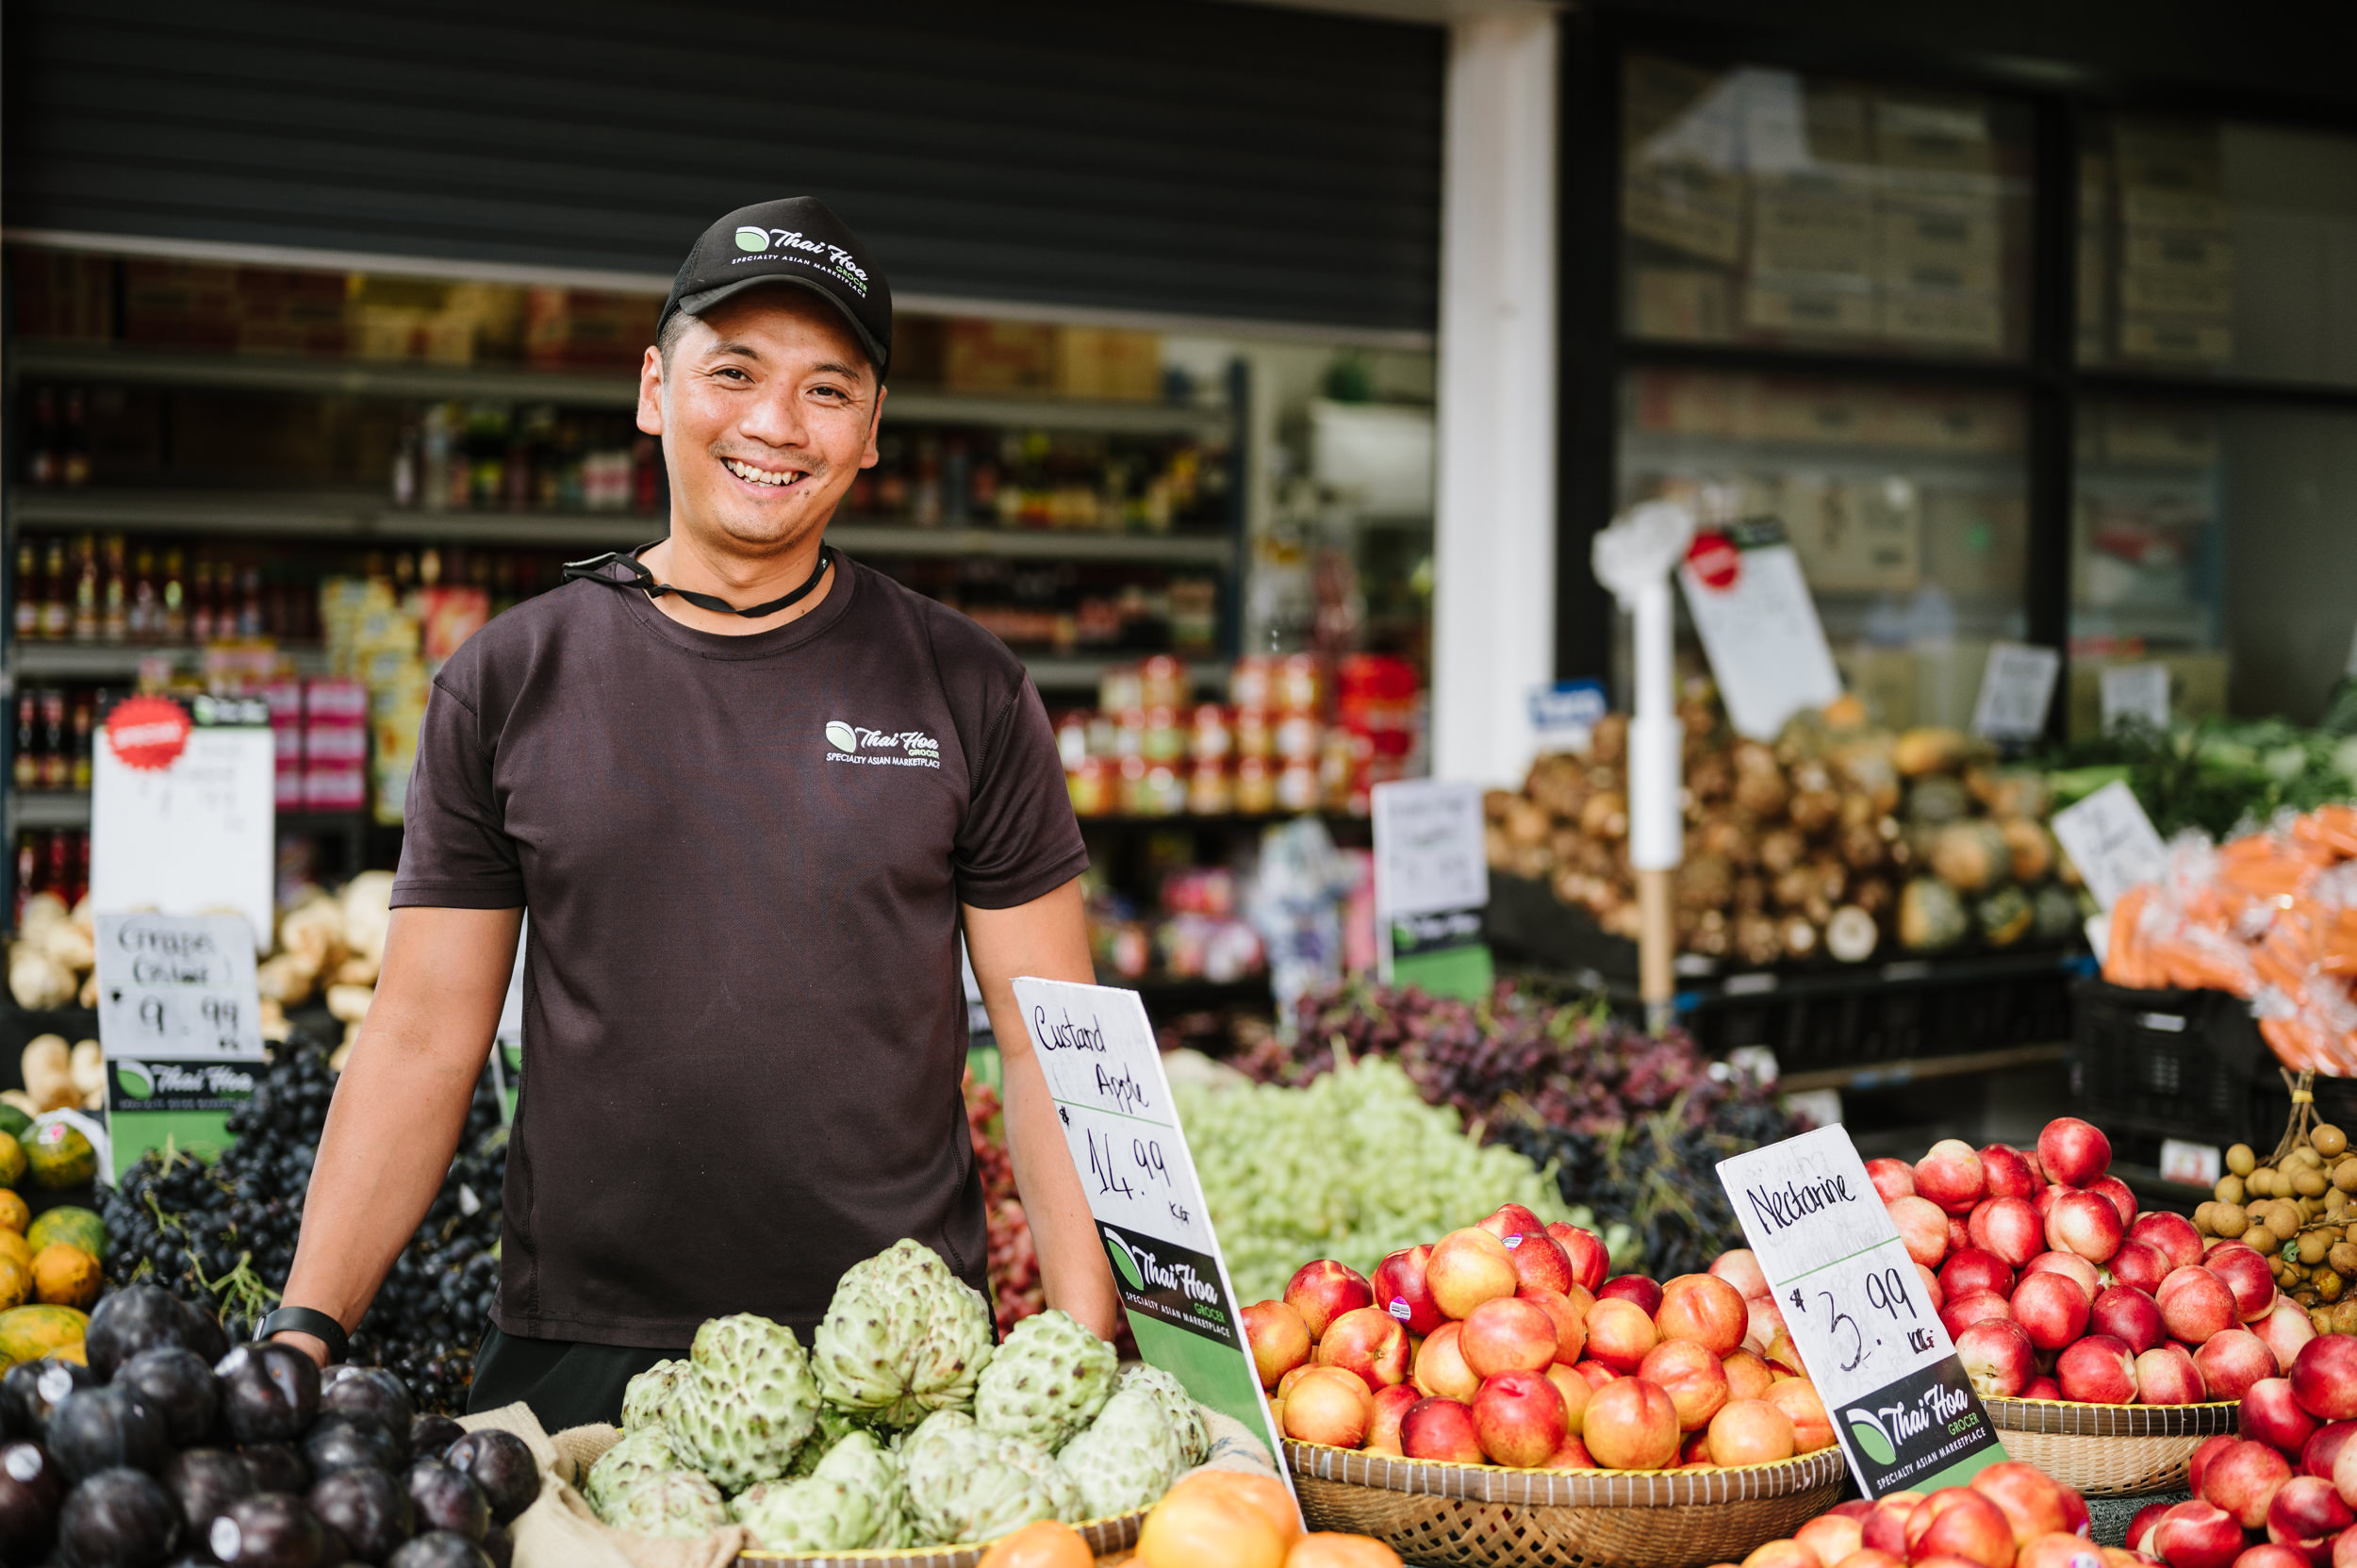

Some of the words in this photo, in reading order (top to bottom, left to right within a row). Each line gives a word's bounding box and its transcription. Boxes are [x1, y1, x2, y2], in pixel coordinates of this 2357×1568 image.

[732, 254, 779, 265] SPECIALTY
[782, 256, 811, 266] ASIAN
[813, 262, 866, 299] MARKETPLACE
[769, 228, 826, 254] Thai
[827, 245, 868, 281] Hoa
[835, 265, 867, 292] GROCER
[826, 752, 866, 765] SPECIALTY
[867, 756, 891, 766] ASIAN
[892, 757, 941, 769] MARKETPLACE
[854, 726, 899, 749] Thai
[899, 732, 939, 751] Hoa
[908, 749, 940, 759] GROCER
[1035, 1005, 1106, 1053] Custard
[1096, 1062, 1149, 1114] Apple
[1746, 1175, 1855, 1235] Nectarine
[1131, 1245, 1178, 1291] Thai
[1175, 1263, 1218, 1305] Hoa
[1125, 1291, 1159, 1312] SPECIALTY
[1161, 1302, 1181, 1319] ASIAN
[1182, 1312, 1231, 1339] MARKETPLACE
[1194, 1302, 1226, 1324] GROCER
[1877, 1399, 1930, 1446] Thai
[1923, 1383, 1969, 1426] Hoa
[1947, 1411, 1980, 1437] GROCER
[1876, 1462, 1915, 1491] SPECIALTY
[1916, 1452, 1938, 1471] ASIAN
[1938, 1427, 1986, 1459] MARKETPLACE
